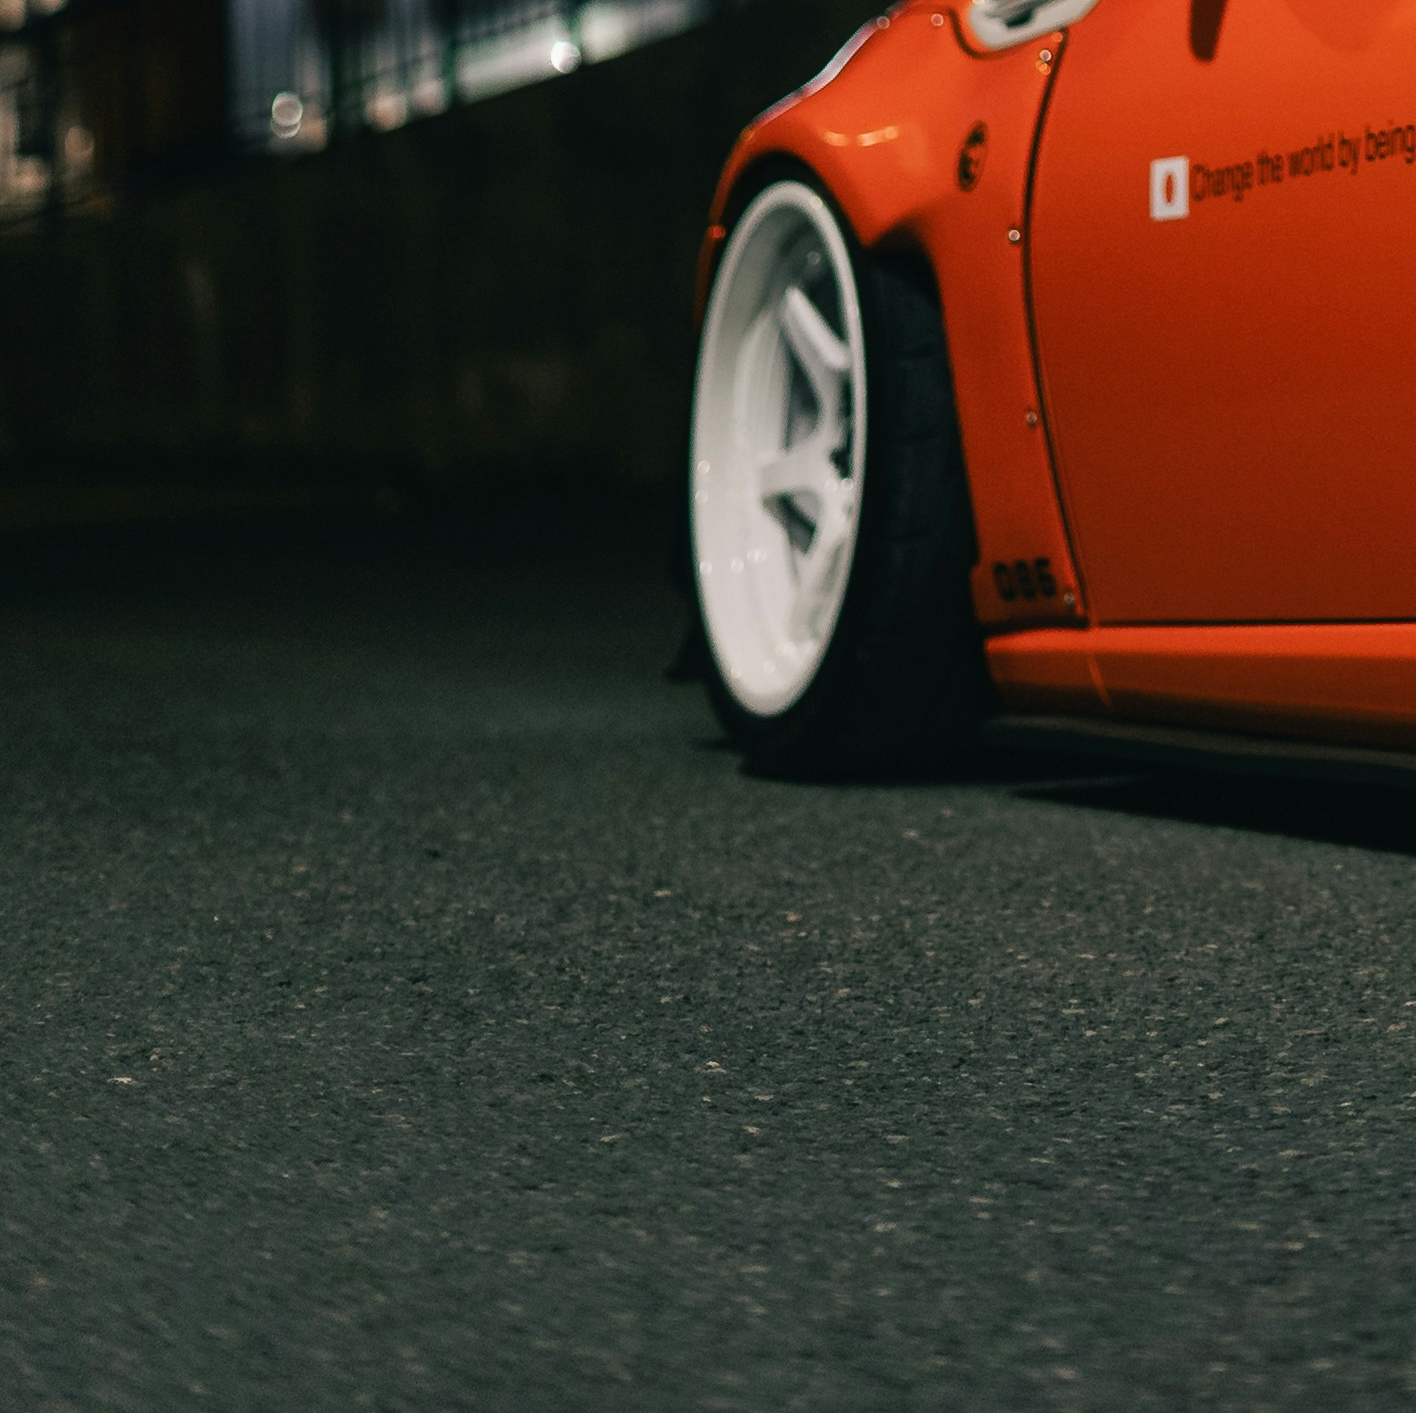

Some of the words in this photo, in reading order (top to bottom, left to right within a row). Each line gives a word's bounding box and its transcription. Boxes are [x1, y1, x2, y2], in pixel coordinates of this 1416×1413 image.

[1189, 162, 1254, 203] Change
[1256, 149, 1284, 185] the
[1288, 132, 1335, 176] world
[1338, 129, 1361, 175] by
[1365, 118, 1416, 164] being
